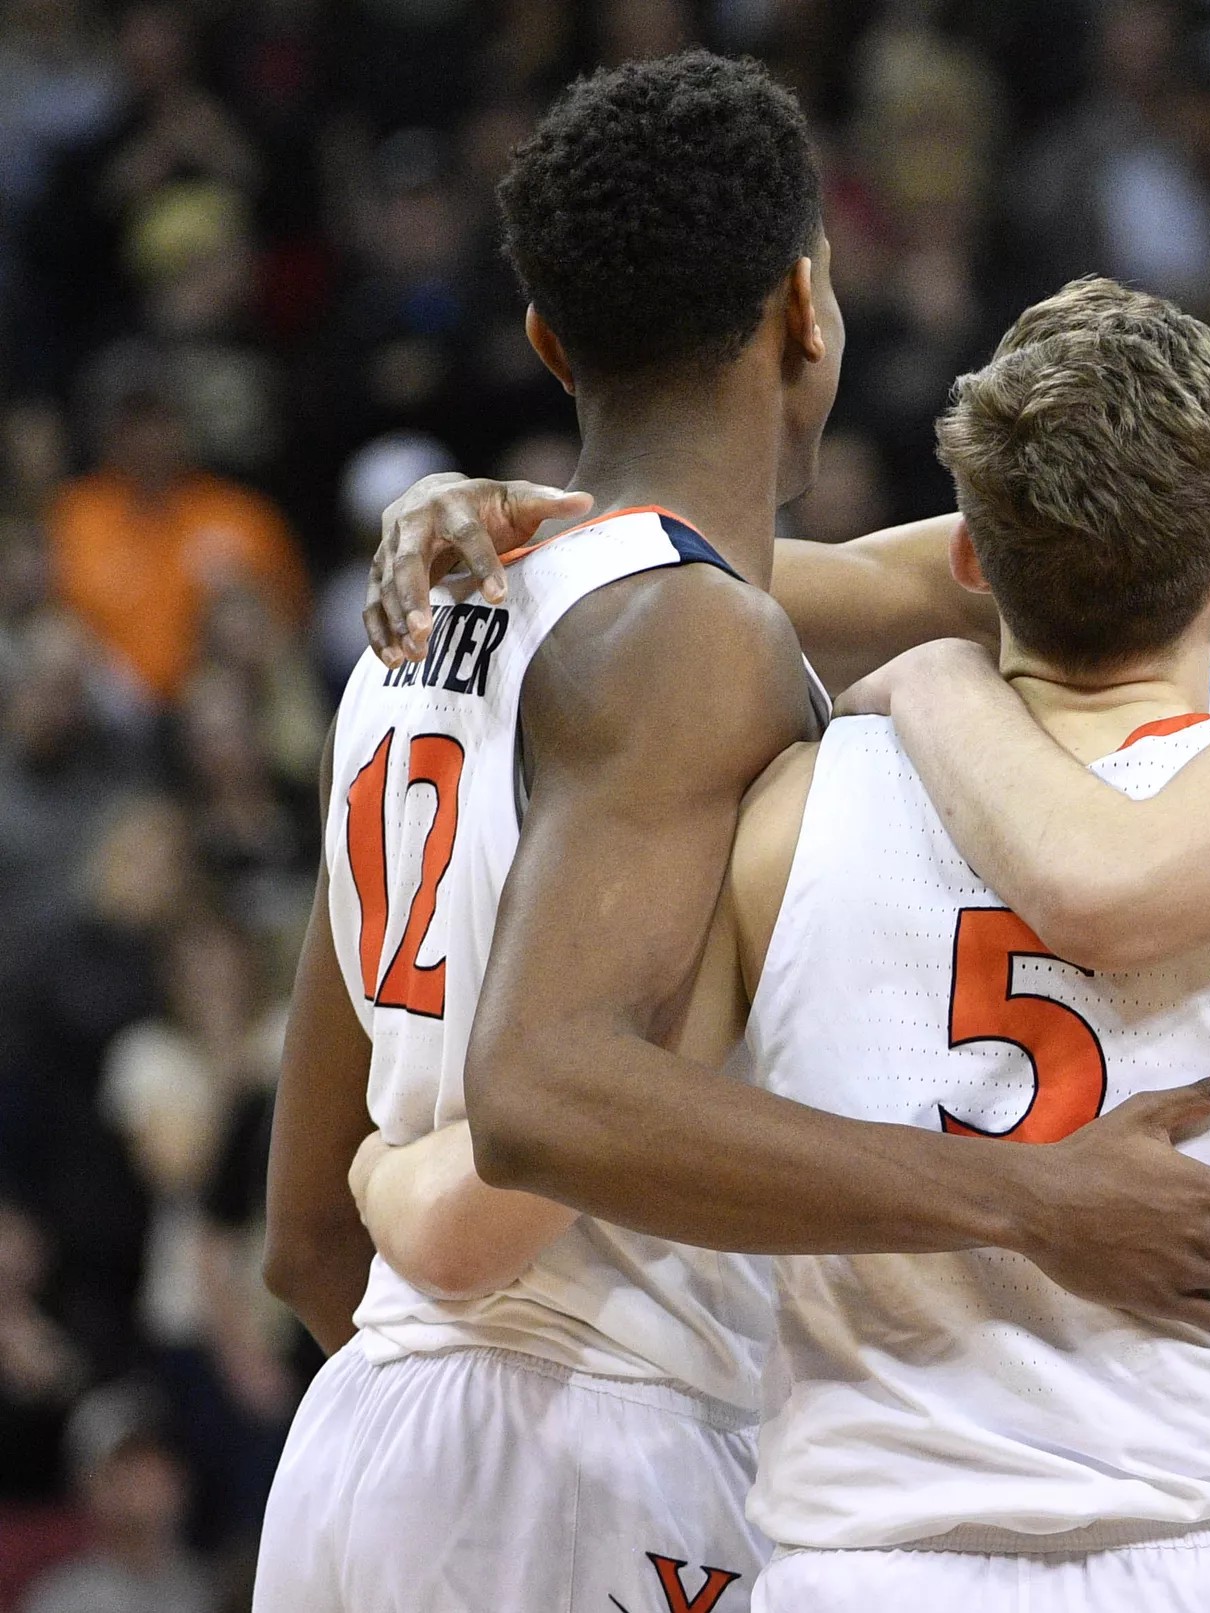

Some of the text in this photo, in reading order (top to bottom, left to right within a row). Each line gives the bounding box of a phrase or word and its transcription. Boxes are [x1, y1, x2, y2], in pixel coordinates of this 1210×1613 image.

[383, 603, 509, 697] NTER
[346, 726, 465, 1020] 12
[937, 907, 1108, 1144] 5
